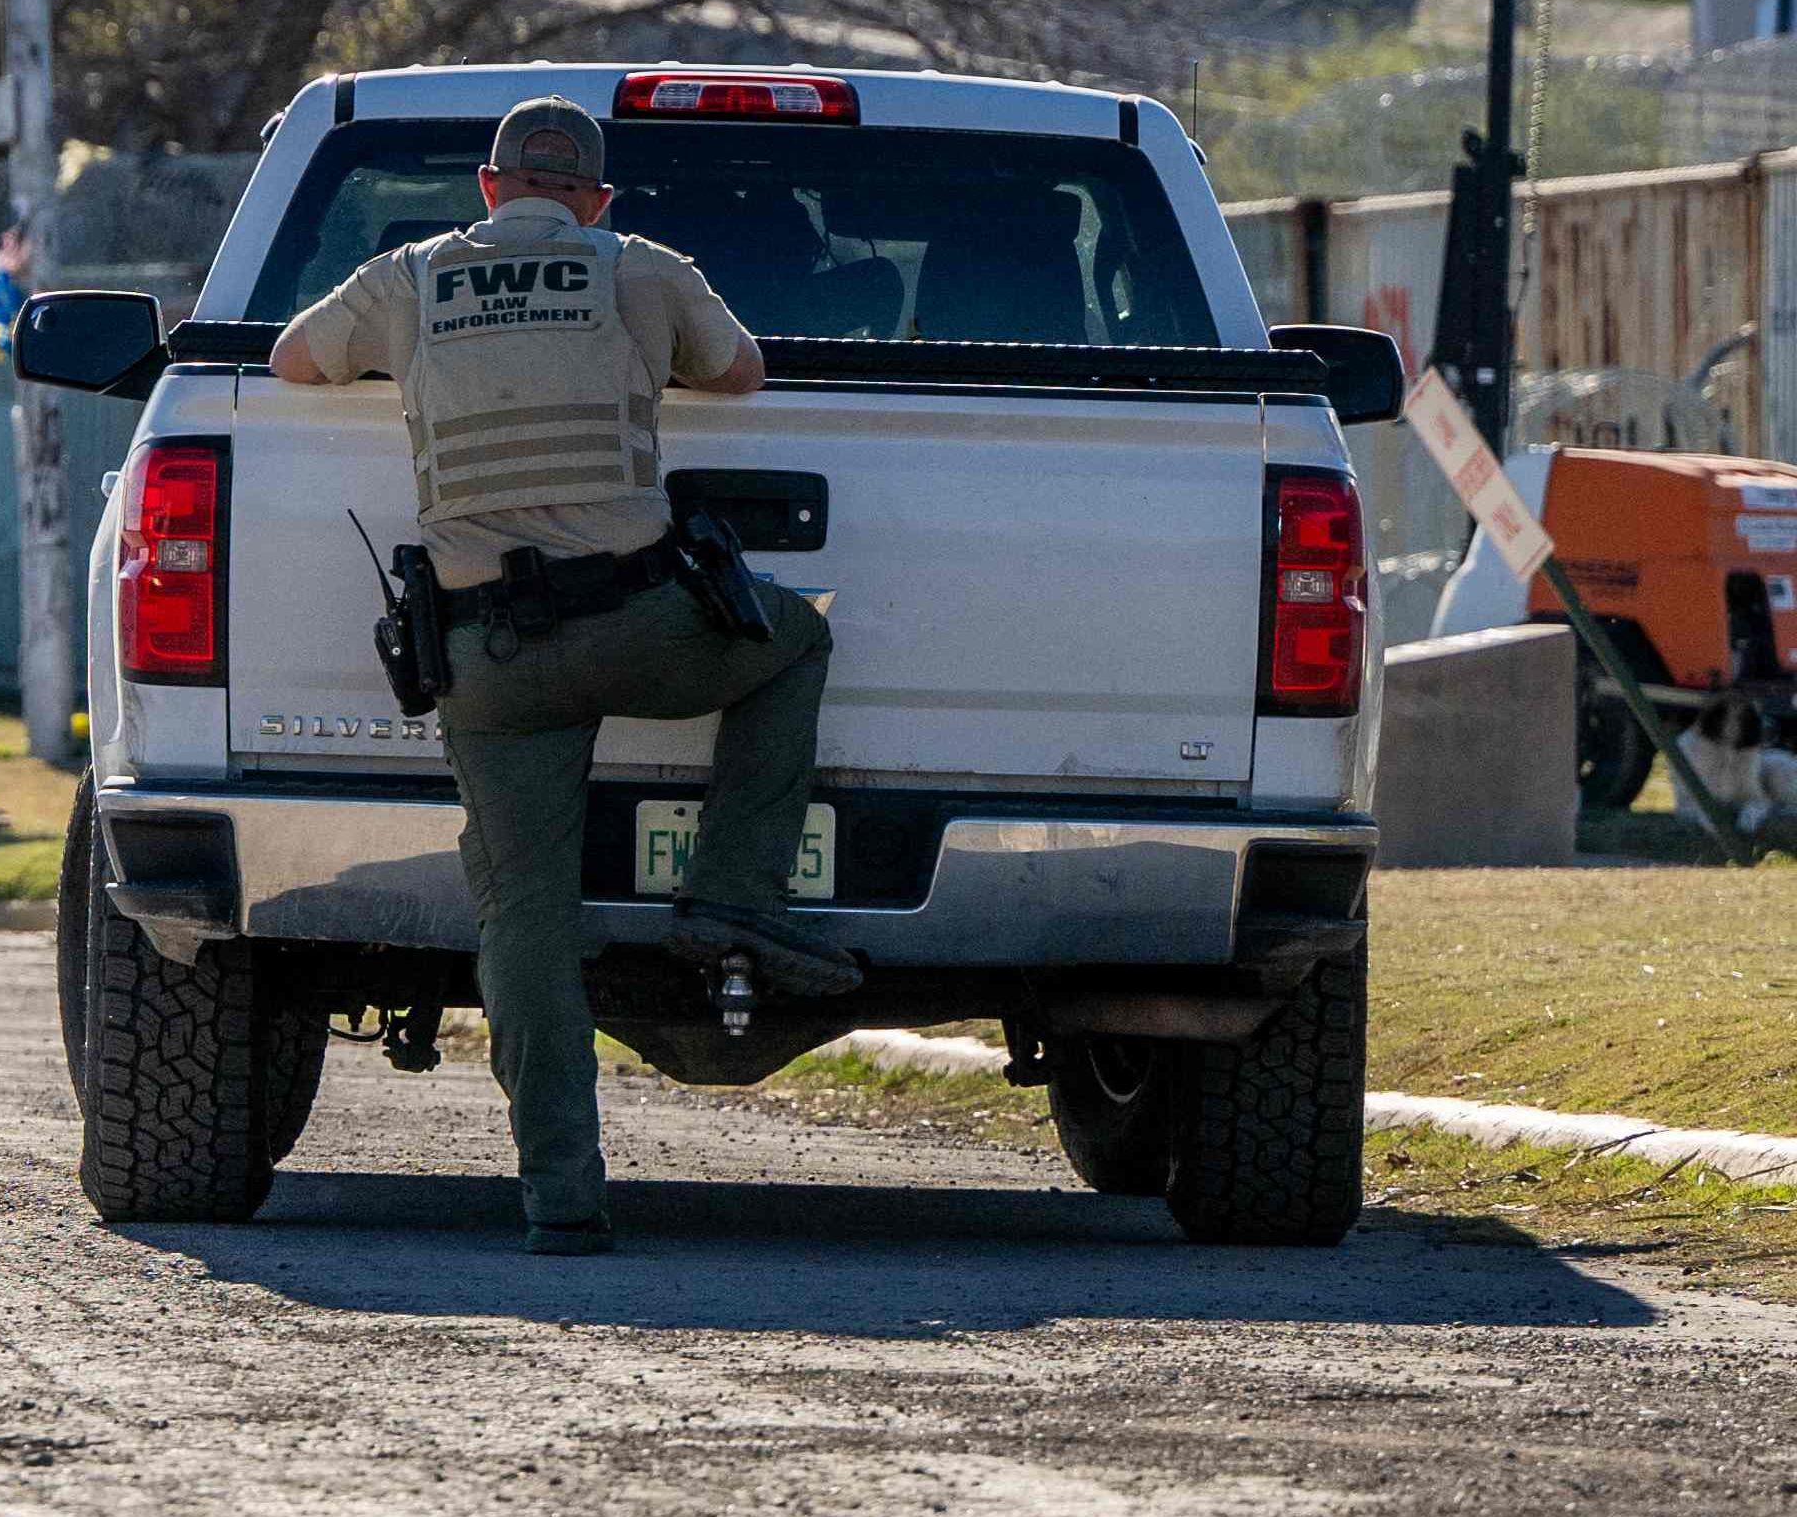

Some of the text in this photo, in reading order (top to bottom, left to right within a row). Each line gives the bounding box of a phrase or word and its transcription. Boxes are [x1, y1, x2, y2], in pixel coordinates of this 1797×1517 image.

[436, 260, 589, 304] FWC
[481, 295, 528, 312] LAW
[432, 309, 593, 334] ENFORCEMENT
[1180, 741, 1214, 761] LT
